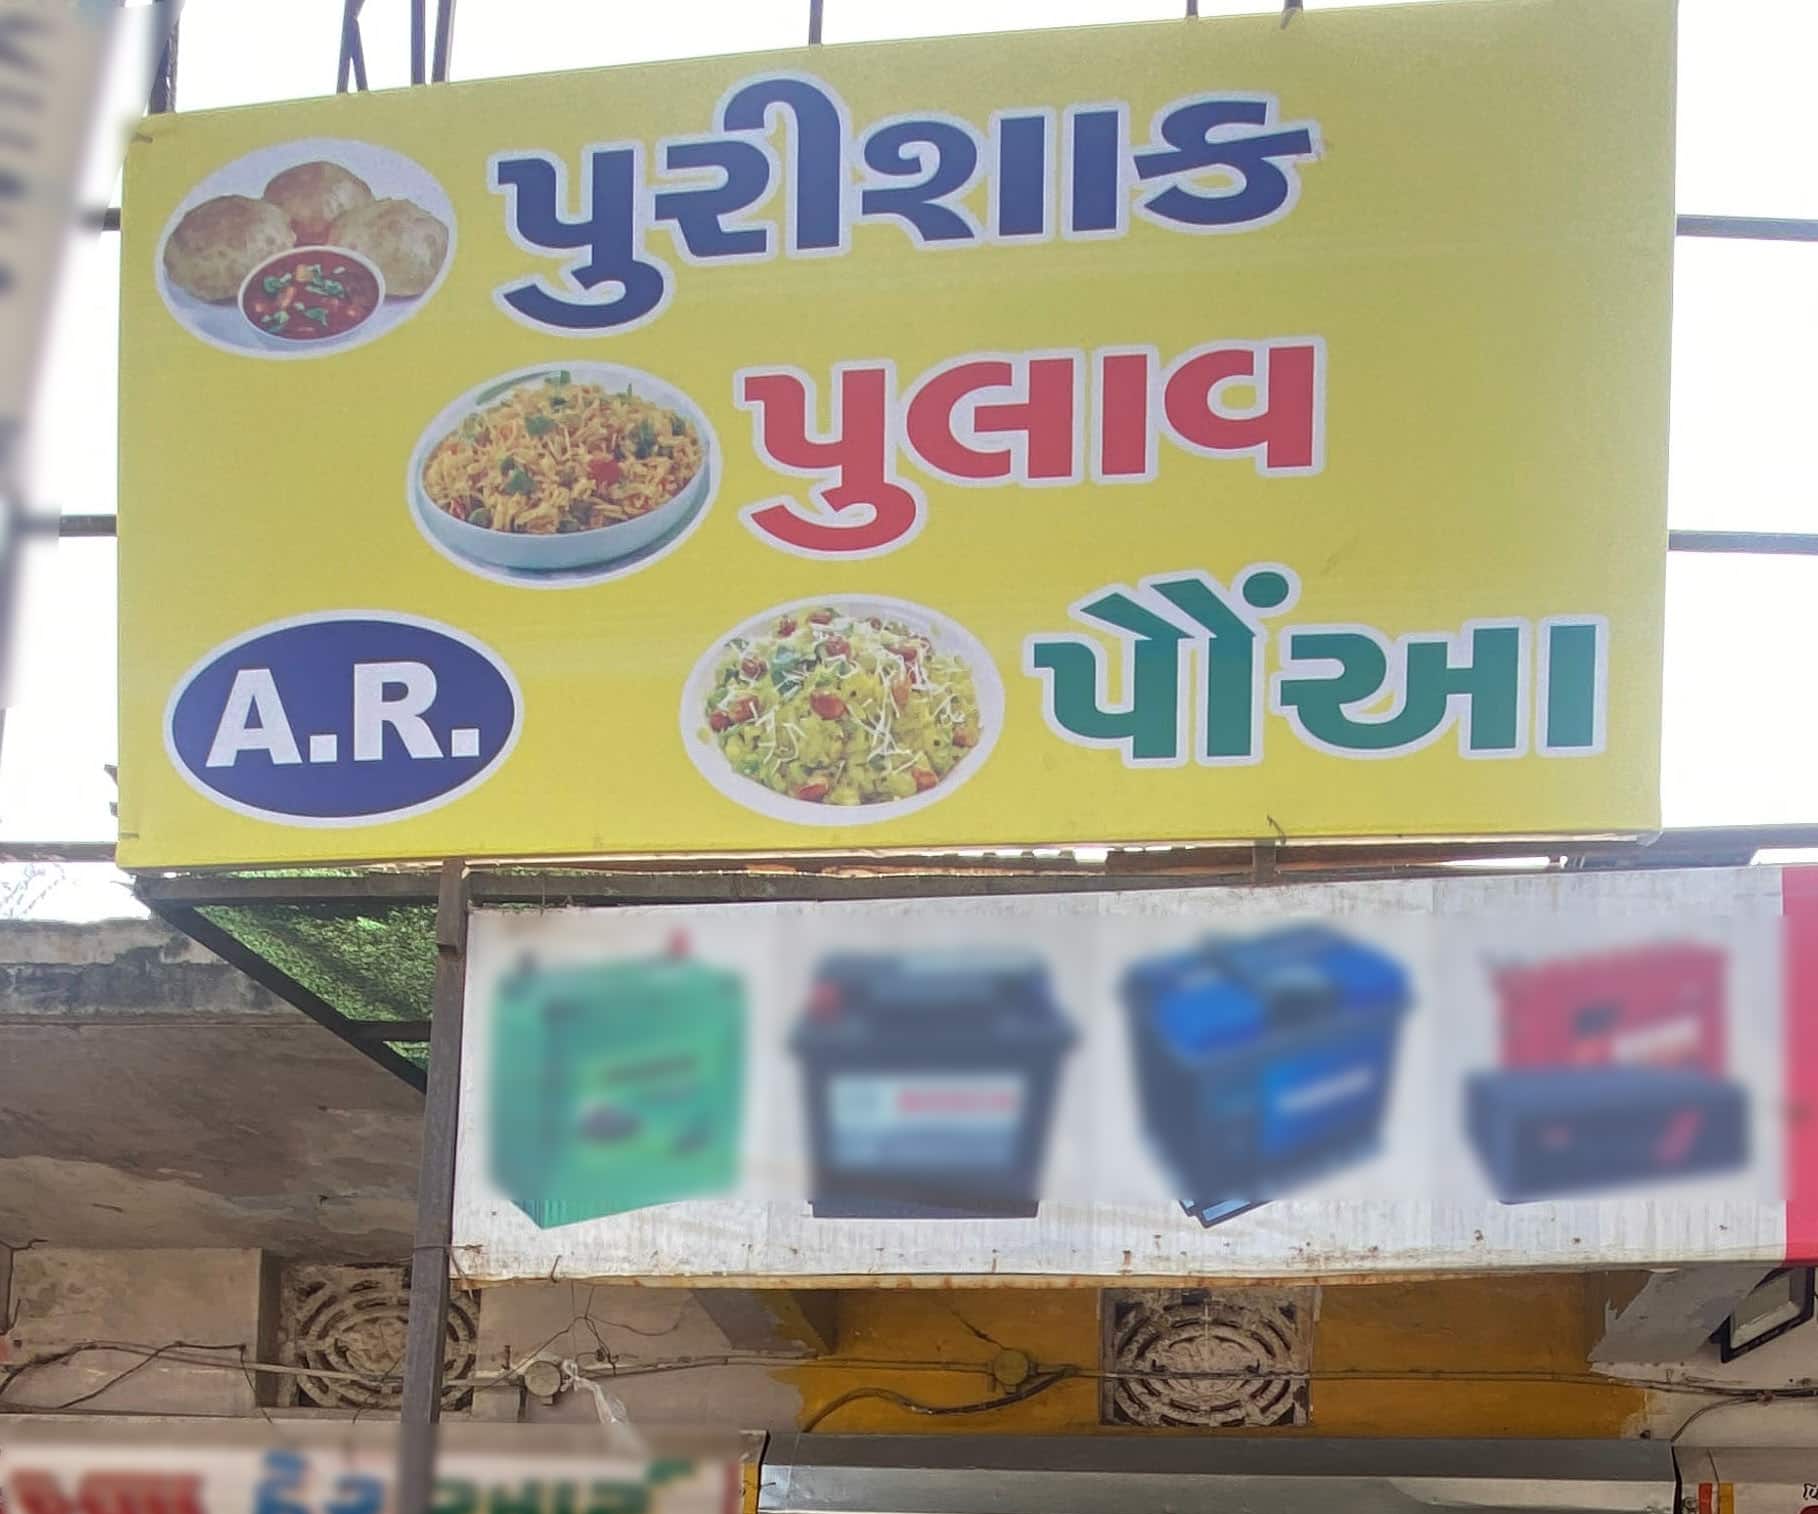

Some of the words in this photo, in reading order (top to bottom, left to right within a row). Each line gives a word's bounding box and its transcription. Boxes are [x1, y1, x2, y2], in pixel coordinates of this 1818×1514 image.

[498, 79, 1311, 328] પુરીશાક
[746, 346, 1314, 551] પુલાવ
[205, 661, 481, 768] A.R.
[1034, 571, 1598, 759] પૌંઆ
